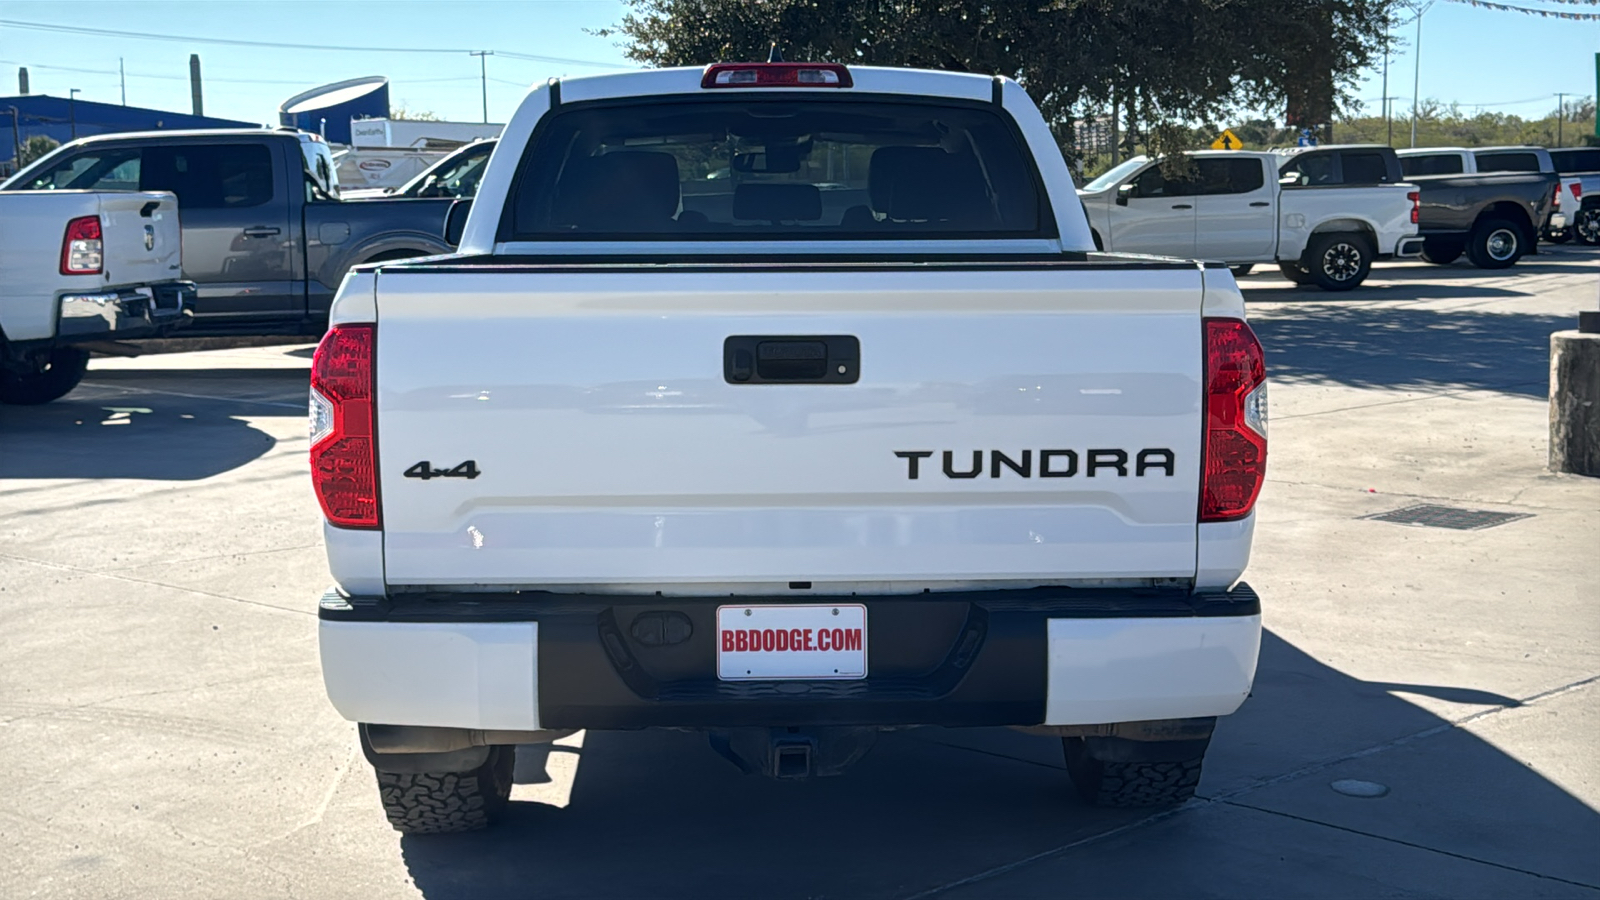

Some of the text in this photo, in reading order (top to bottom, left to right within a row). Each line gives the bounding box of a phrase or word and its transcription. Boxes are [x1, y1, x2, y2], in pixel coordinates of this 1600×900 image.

[403, 460, 481, 480] 4x4
[893, 448, 1175, 479] TUNDRA
[721, 628, 862, 652] BBDODGE.COM
